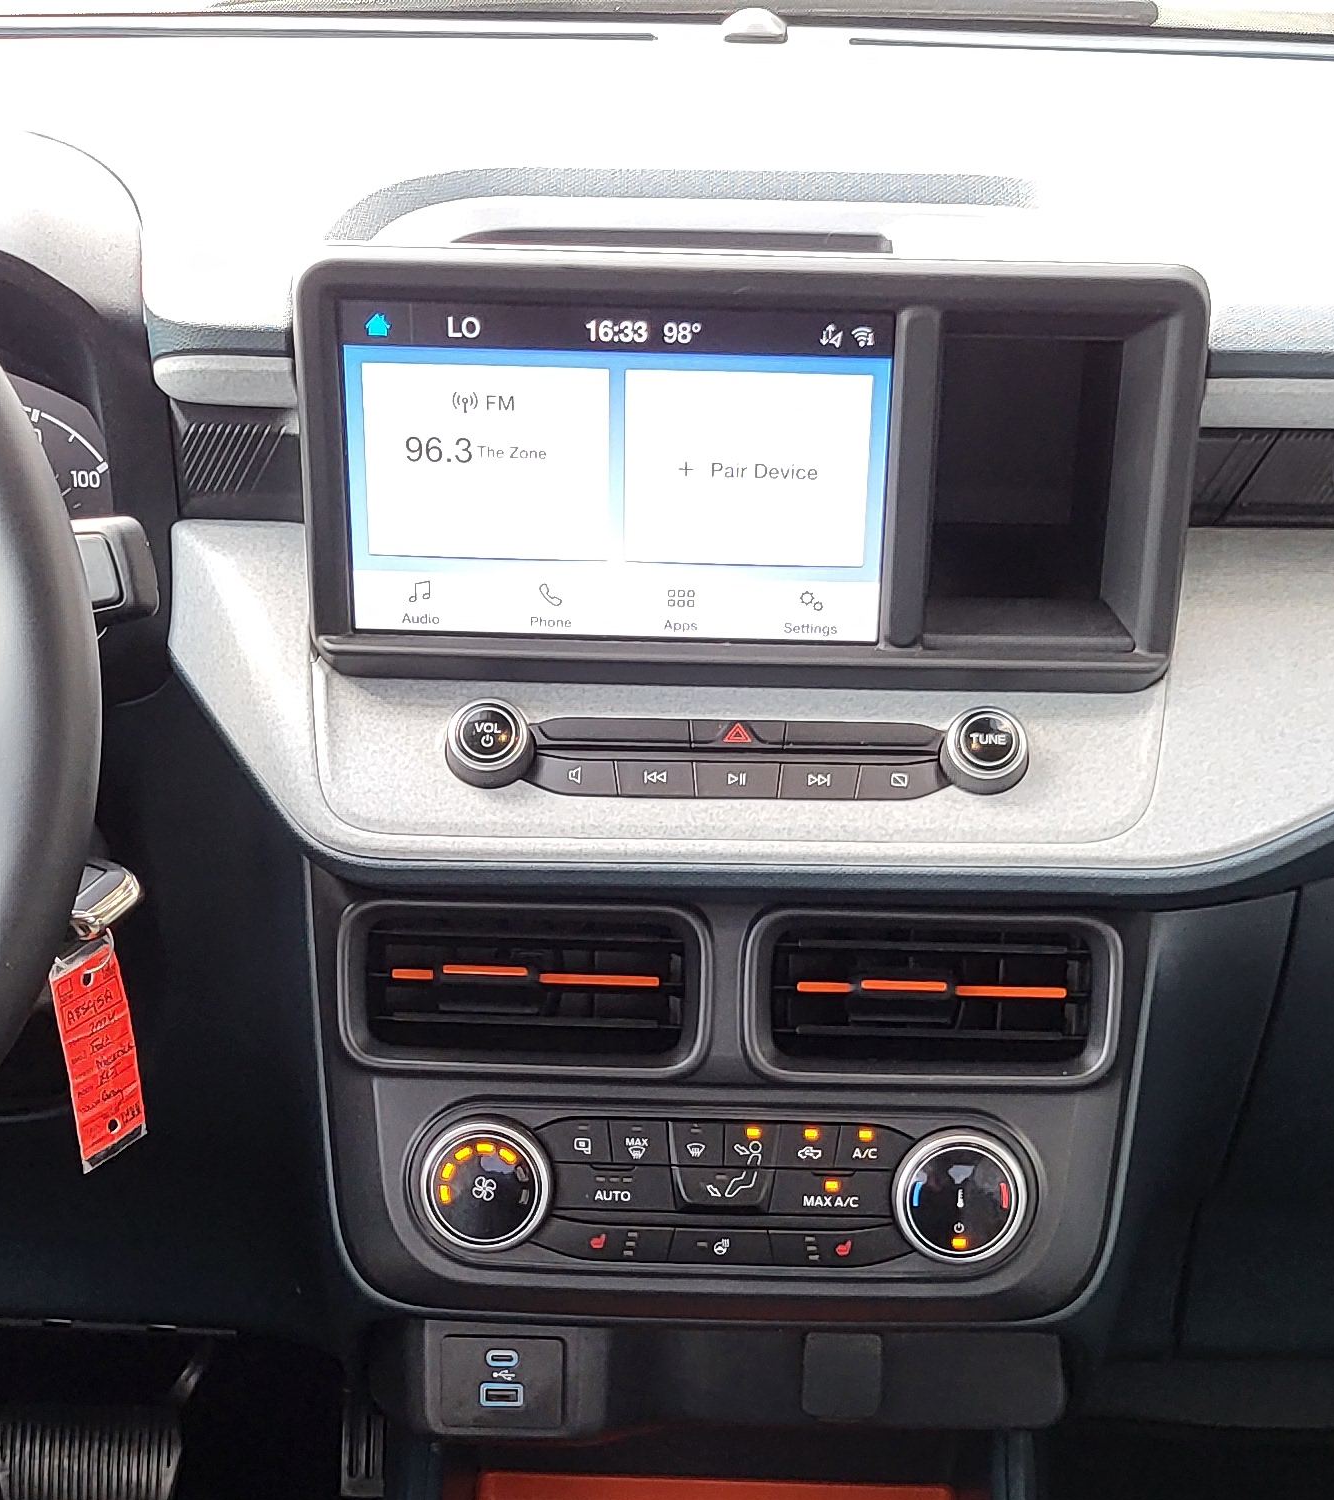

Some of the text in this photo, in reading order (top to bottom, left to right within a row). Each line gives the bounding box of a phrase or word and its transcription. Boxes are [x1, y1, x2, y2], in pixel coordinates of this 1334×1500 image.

[446, 316, 480, 339] LO
[585, 319, 702, 344] 16:33 98°
[486, 395, 515, 412] FM
[405, 436, 547, 463] 96.3 The Zone
[710, 461, 819, 482] Pair Device
[70, 470, 101, 489] 100
[401, 613, 440, 626] Audio
[530, 616, 572, 629] Phone
[663, 619, 698, 634] Apps
[783, 621, 838, 637] Settings
[474, 722, 502, 734] VOL
[969, 733, 1007, 745] TUNE
[625, 1137, 649, 1147] MAX
[852, 1147, 878, 1160] A/C
[594, 1190, 631, 1202] AUTO
[803, 1196, 860, 1209] MAX A/C
